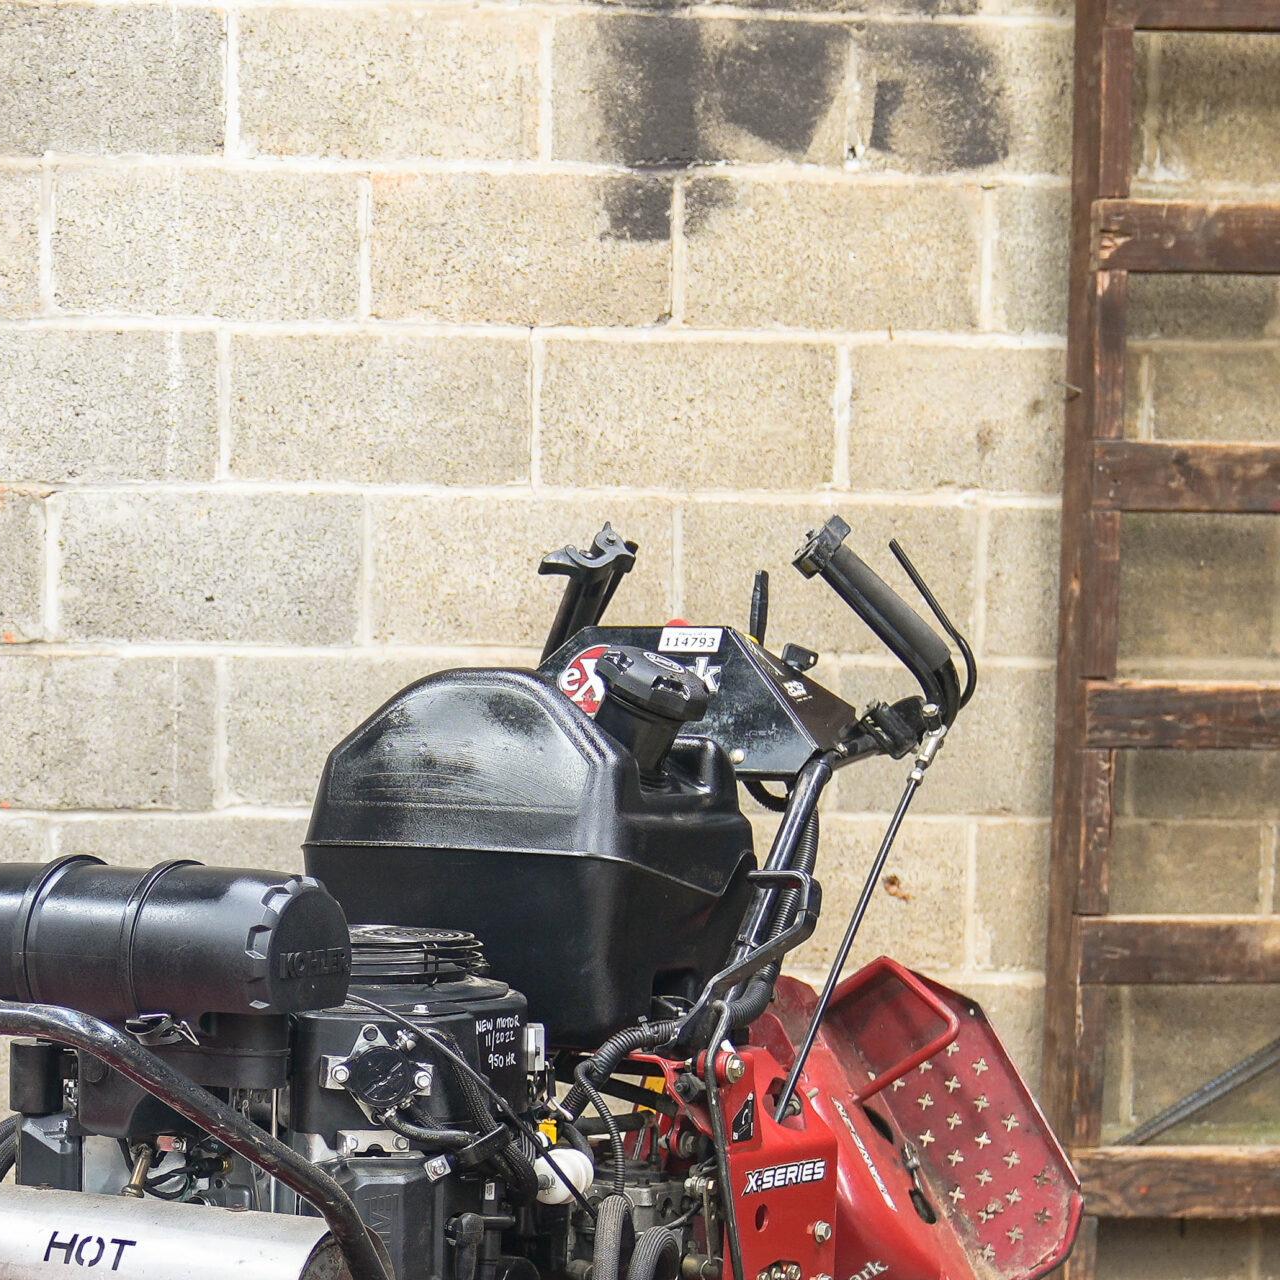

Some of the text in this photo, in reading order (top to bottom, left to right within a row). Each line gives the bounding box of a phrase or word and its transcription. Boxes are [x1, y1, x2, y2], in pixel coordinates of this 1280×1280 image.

[665, 637, 716, 648] 114793
[475, 1014, 520, 1036] NEW MOTOR
[485, 1030, 516, 1052] 11/2022
[487, 1051, 516, 1070] 950 HR
[43, 1230, 138, 1271] HOT
